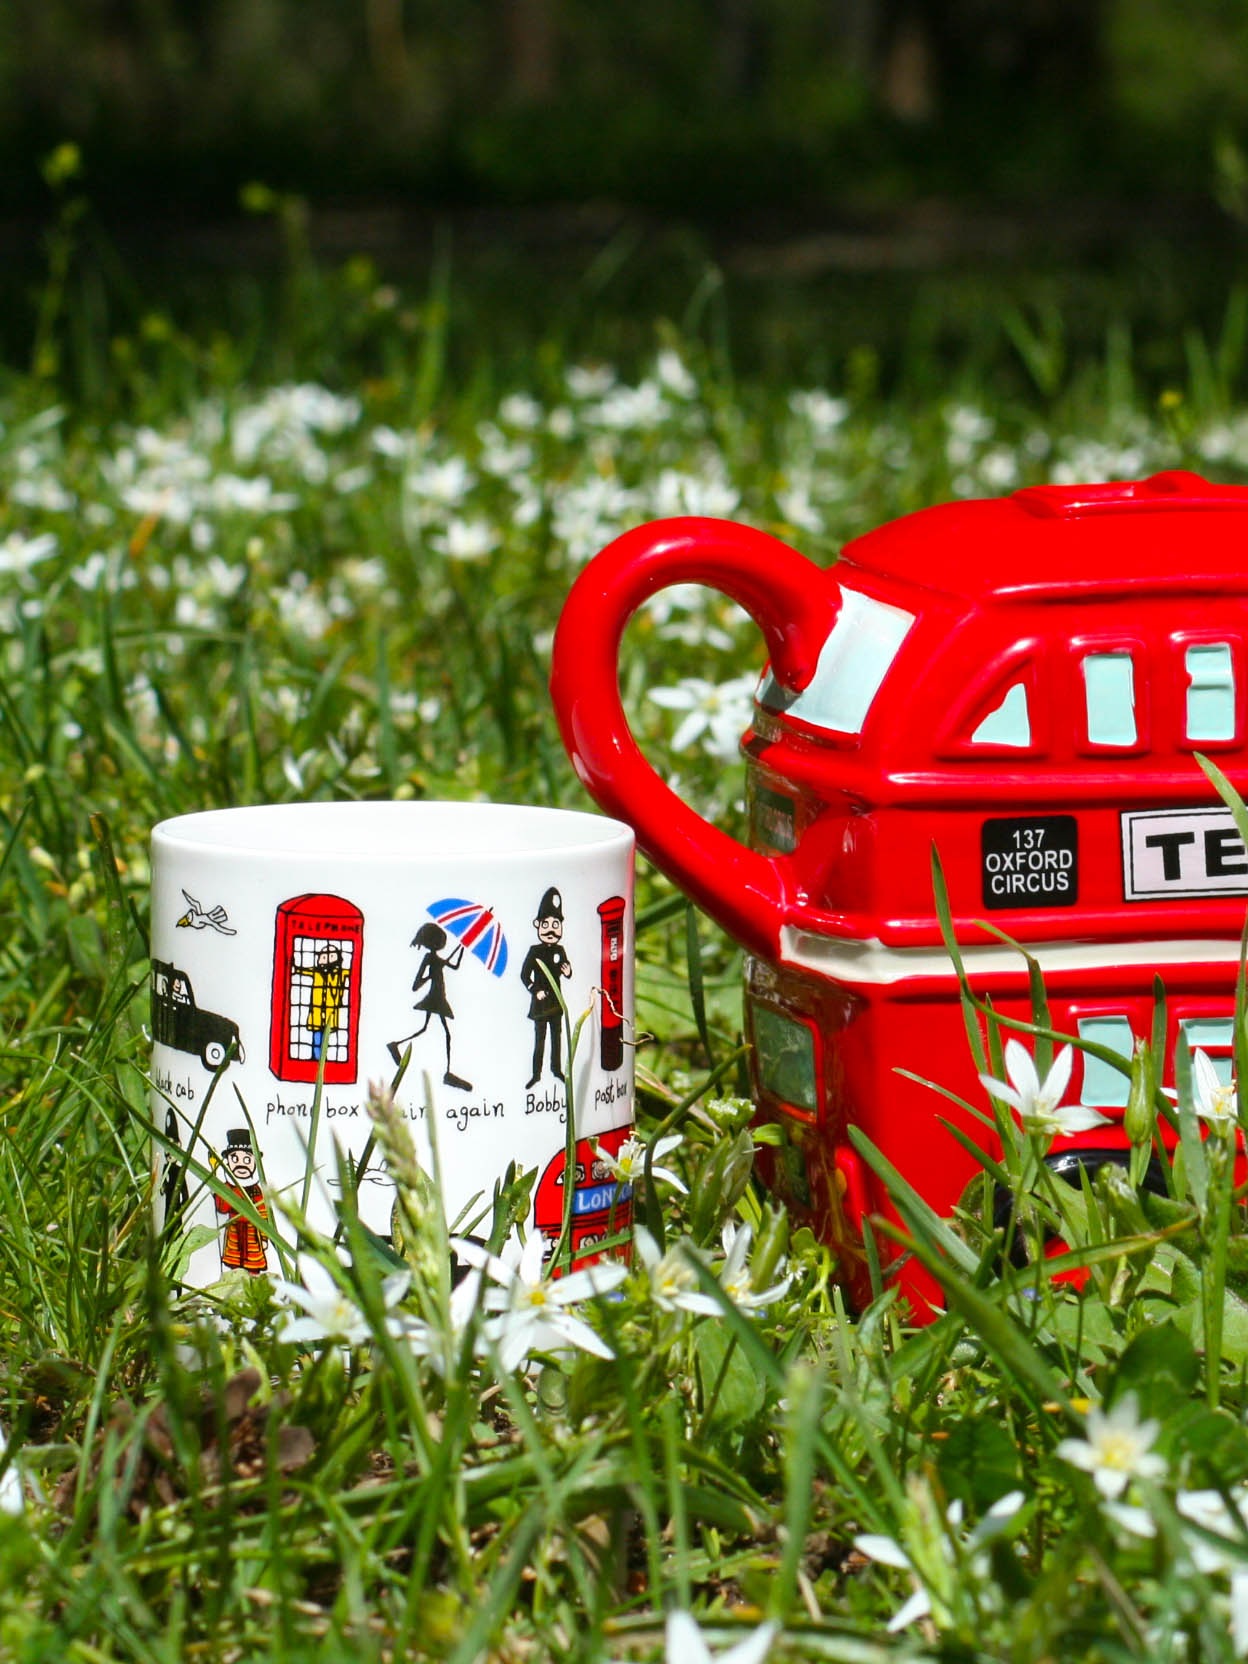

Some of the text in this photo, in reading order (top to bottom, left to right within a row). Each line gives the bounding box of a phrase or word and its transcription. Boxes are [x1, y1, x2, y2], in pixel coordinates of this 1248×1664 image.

[1012, 828, 1045, 849] 137
[985, 849, 1073, 873] OXFORD
[991, 871, 1070, 895] CIRCUS
[175, 1076, 194, 1101] cab
[594, 1079, 614, 1111] post
[266, 1093, 359, 1125] phon box
[446, 1099, 504, 1132] again
[525, 1083, 567, 1124] Bobby
